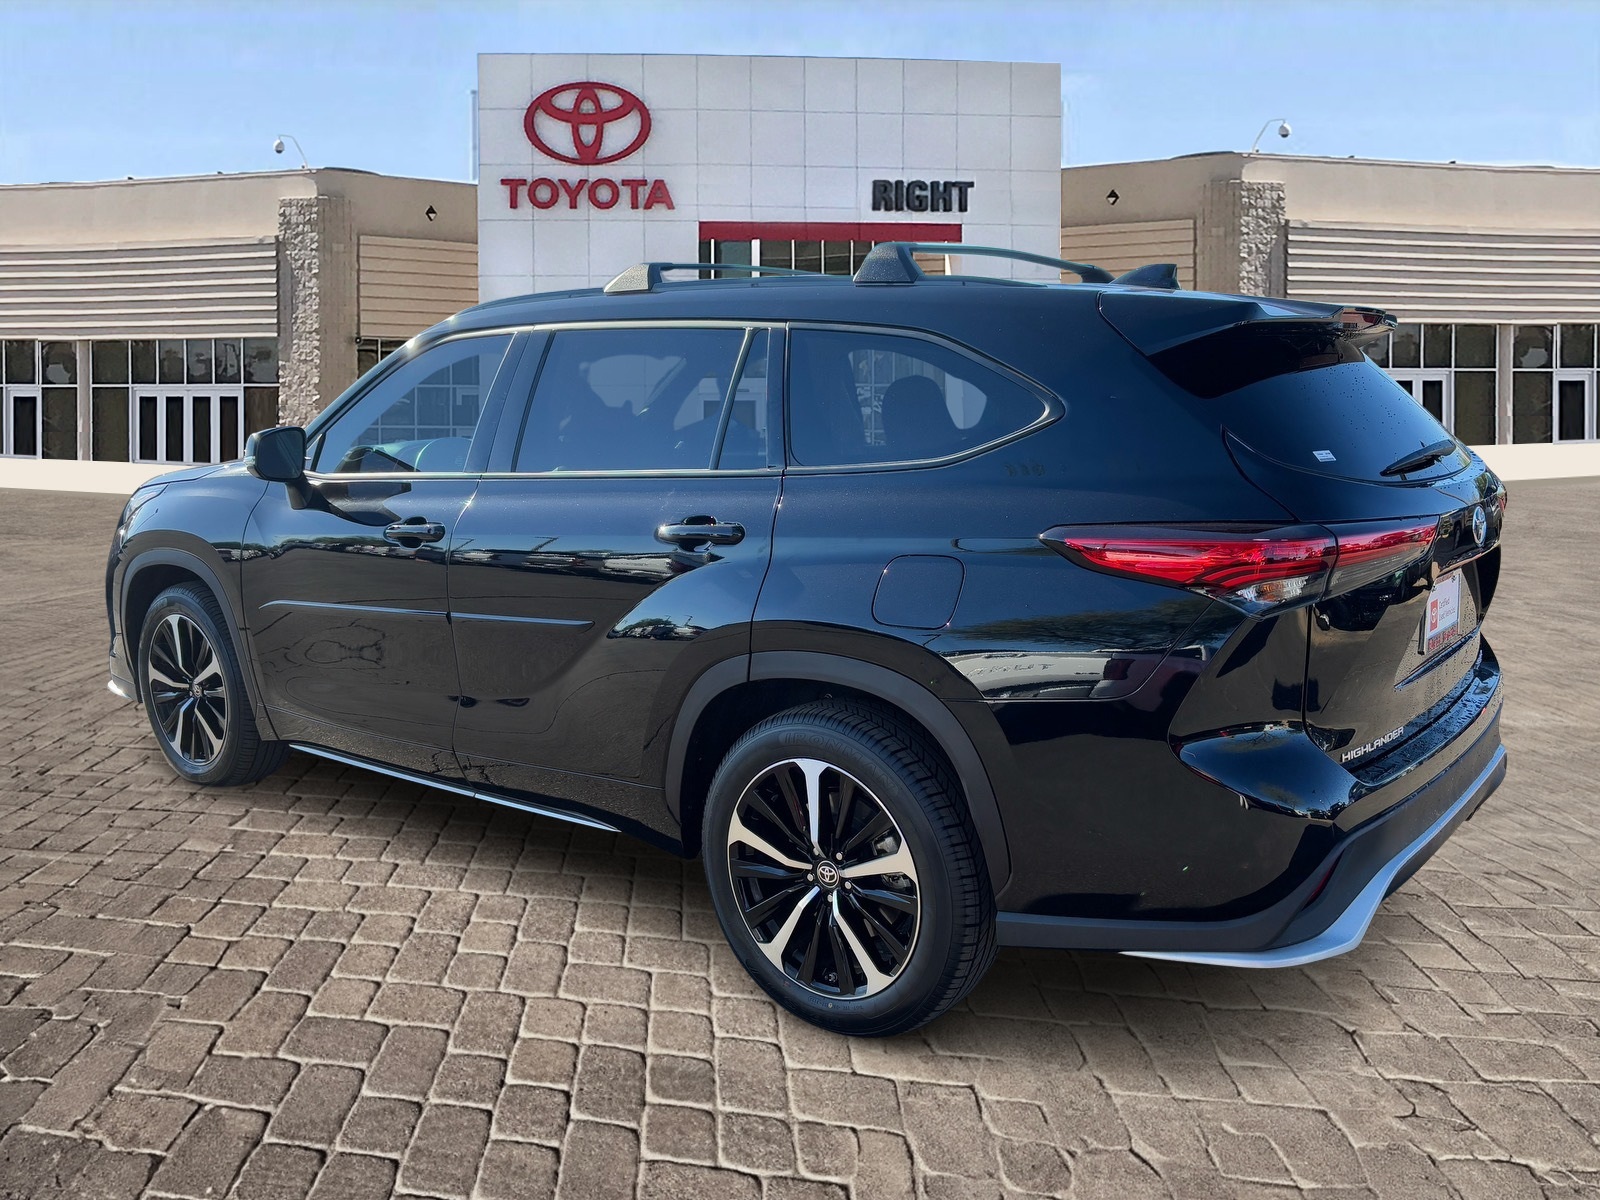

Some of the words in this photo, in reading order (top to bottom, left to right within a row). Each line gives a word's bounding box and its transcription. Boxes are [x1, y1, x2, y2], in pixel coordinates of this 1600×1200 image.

[500, 178, 675, 211] TOYOTA
[872, 179, 975, 212] RIGHT
[1341, 726, 1404, 763] HIGHLANDER
[784, 732, 899, 794] IRONMAN
